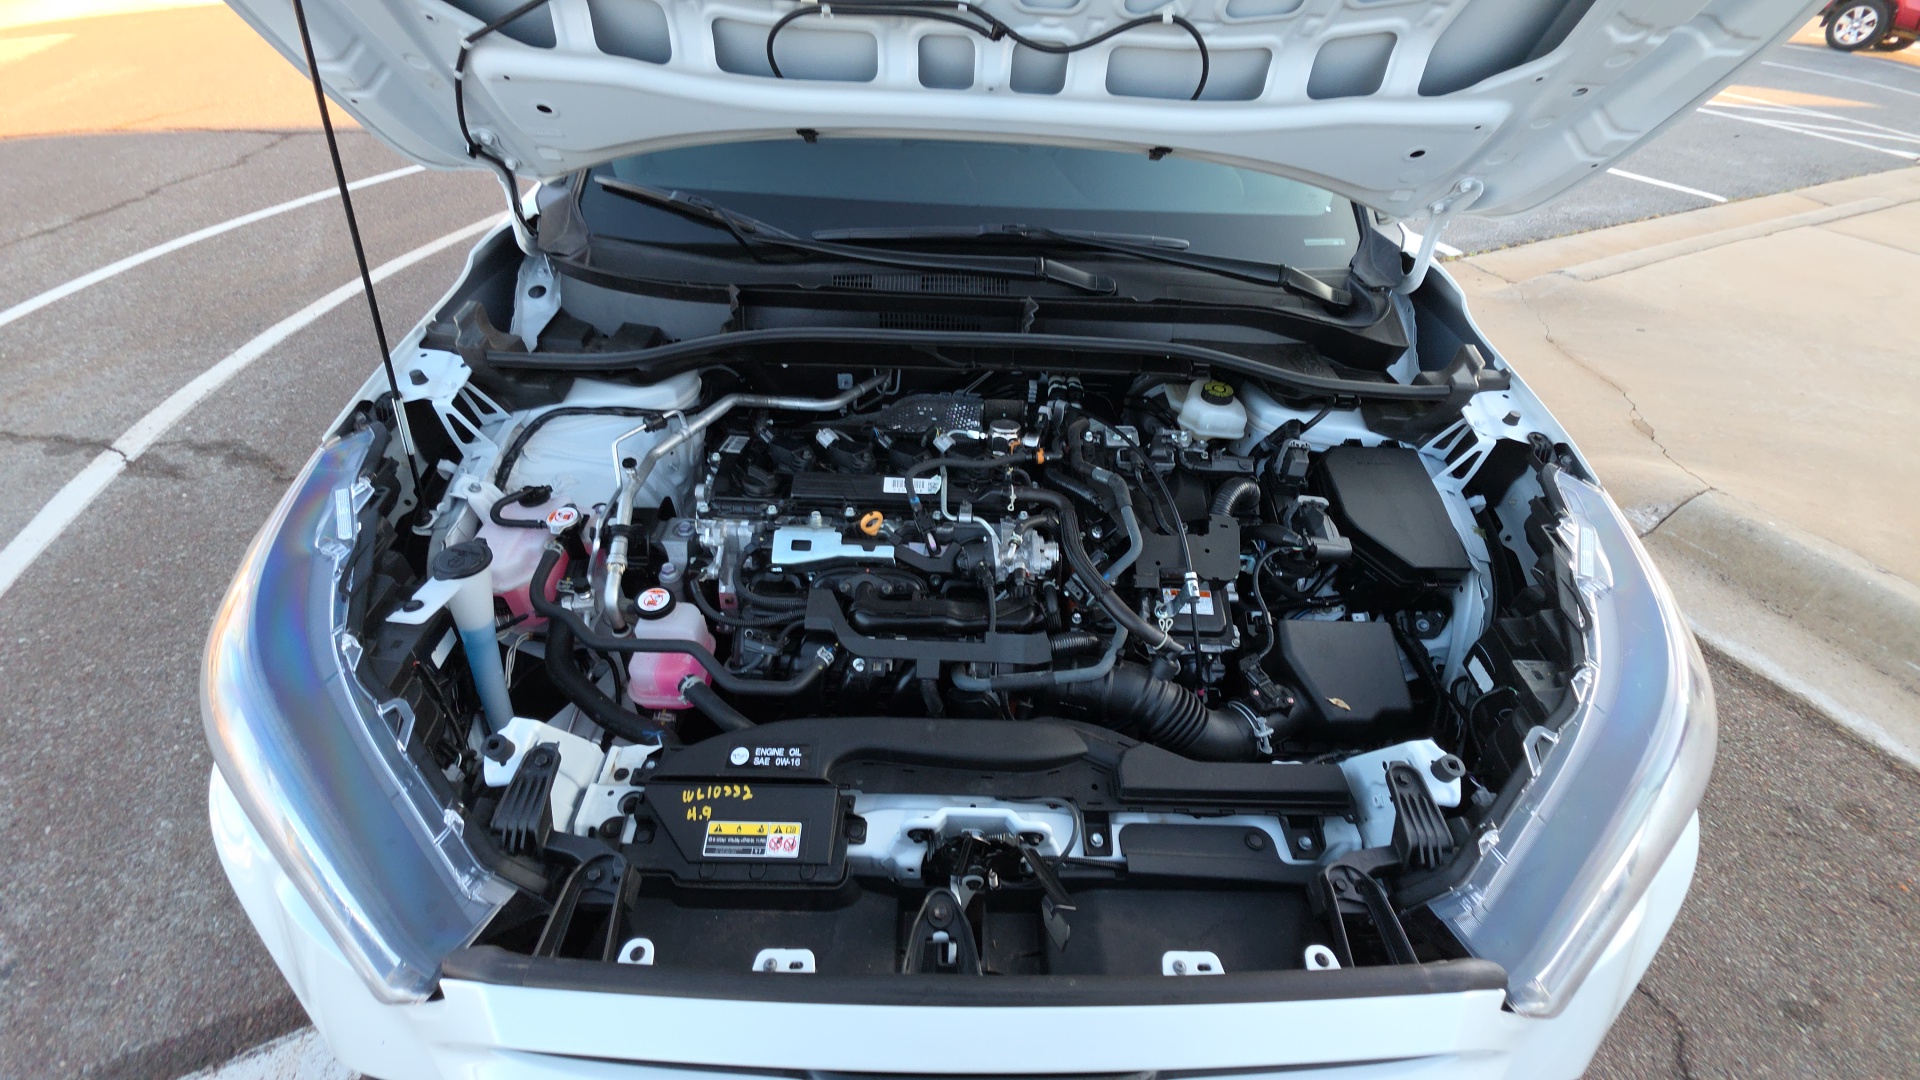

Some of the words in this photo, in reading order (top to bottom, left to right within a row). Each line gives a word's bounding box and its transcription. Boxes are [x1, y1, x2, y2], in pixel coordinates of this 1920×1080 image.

[755, 747, 784, 757] ENGINE
[789, 747, 802, 757] OIL
[753, 757, 770, 766] SAE
[775, 757, 801, 767] 0W-16
